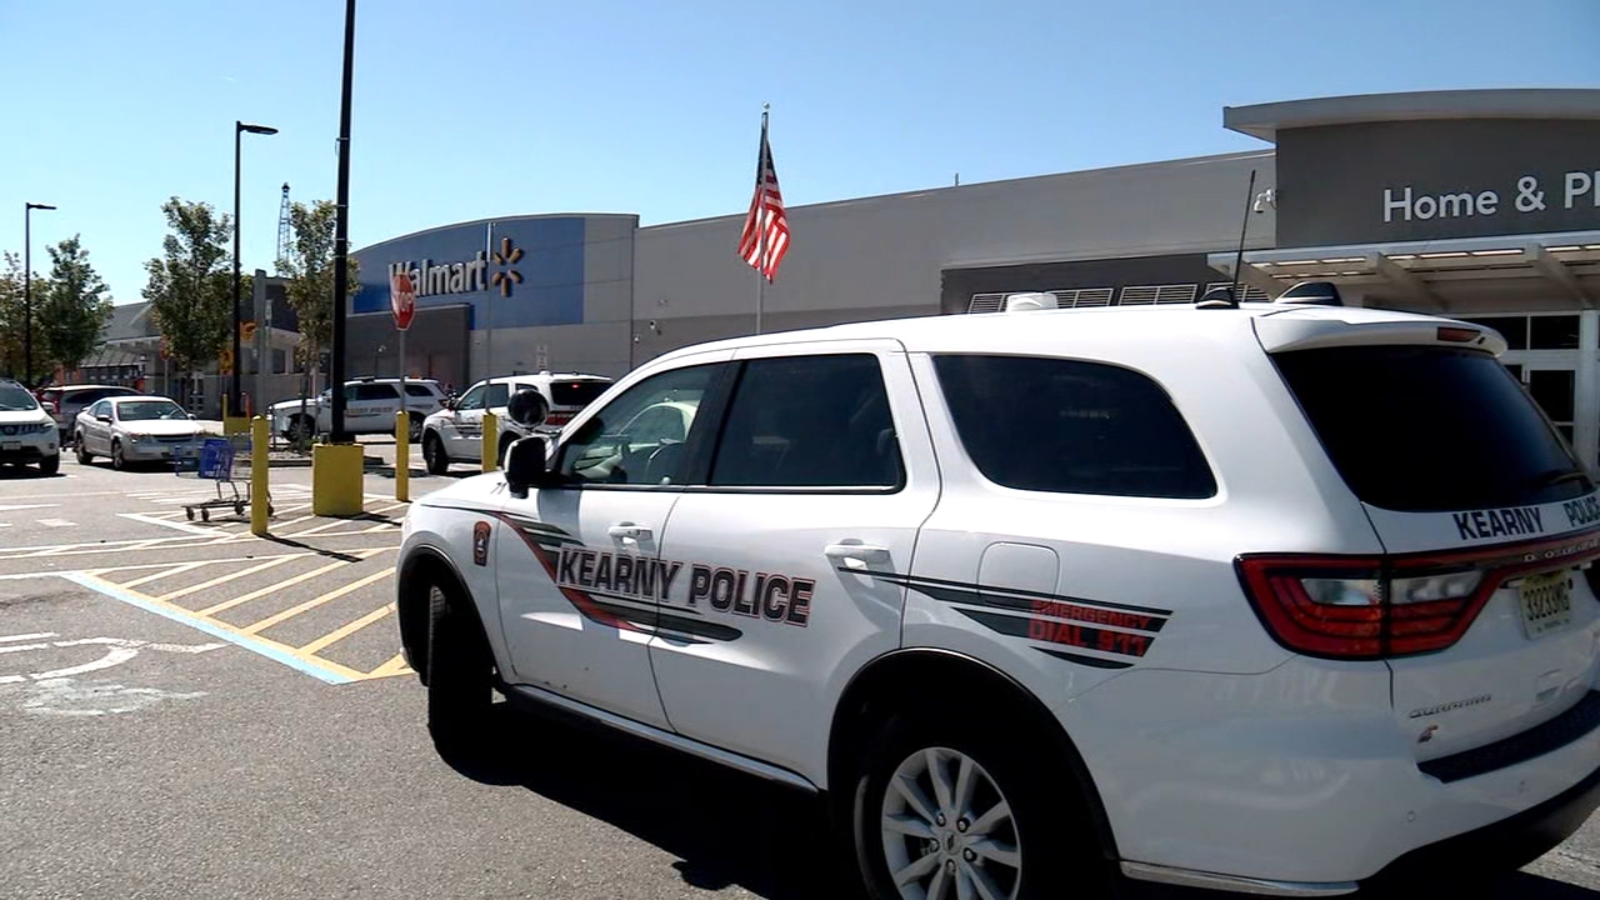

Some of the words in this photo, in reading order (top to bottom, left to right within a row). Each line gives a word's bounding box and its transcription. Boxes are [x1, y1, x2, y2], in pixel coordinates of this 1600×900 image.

[1384, 187, 1499, 223] Home
[1515, 175, 1547, 212] &
[1453, 507, 1545, 541] KEARNY
[557, 543, 684, 602] KEARNY
[687, 562, 816, 628] POLICE
[1030, 599, 1152, 629] EMERGENCY
[1027, 617, 1088, 648] DIAL
[1098, 628, 1147, 657] 911
